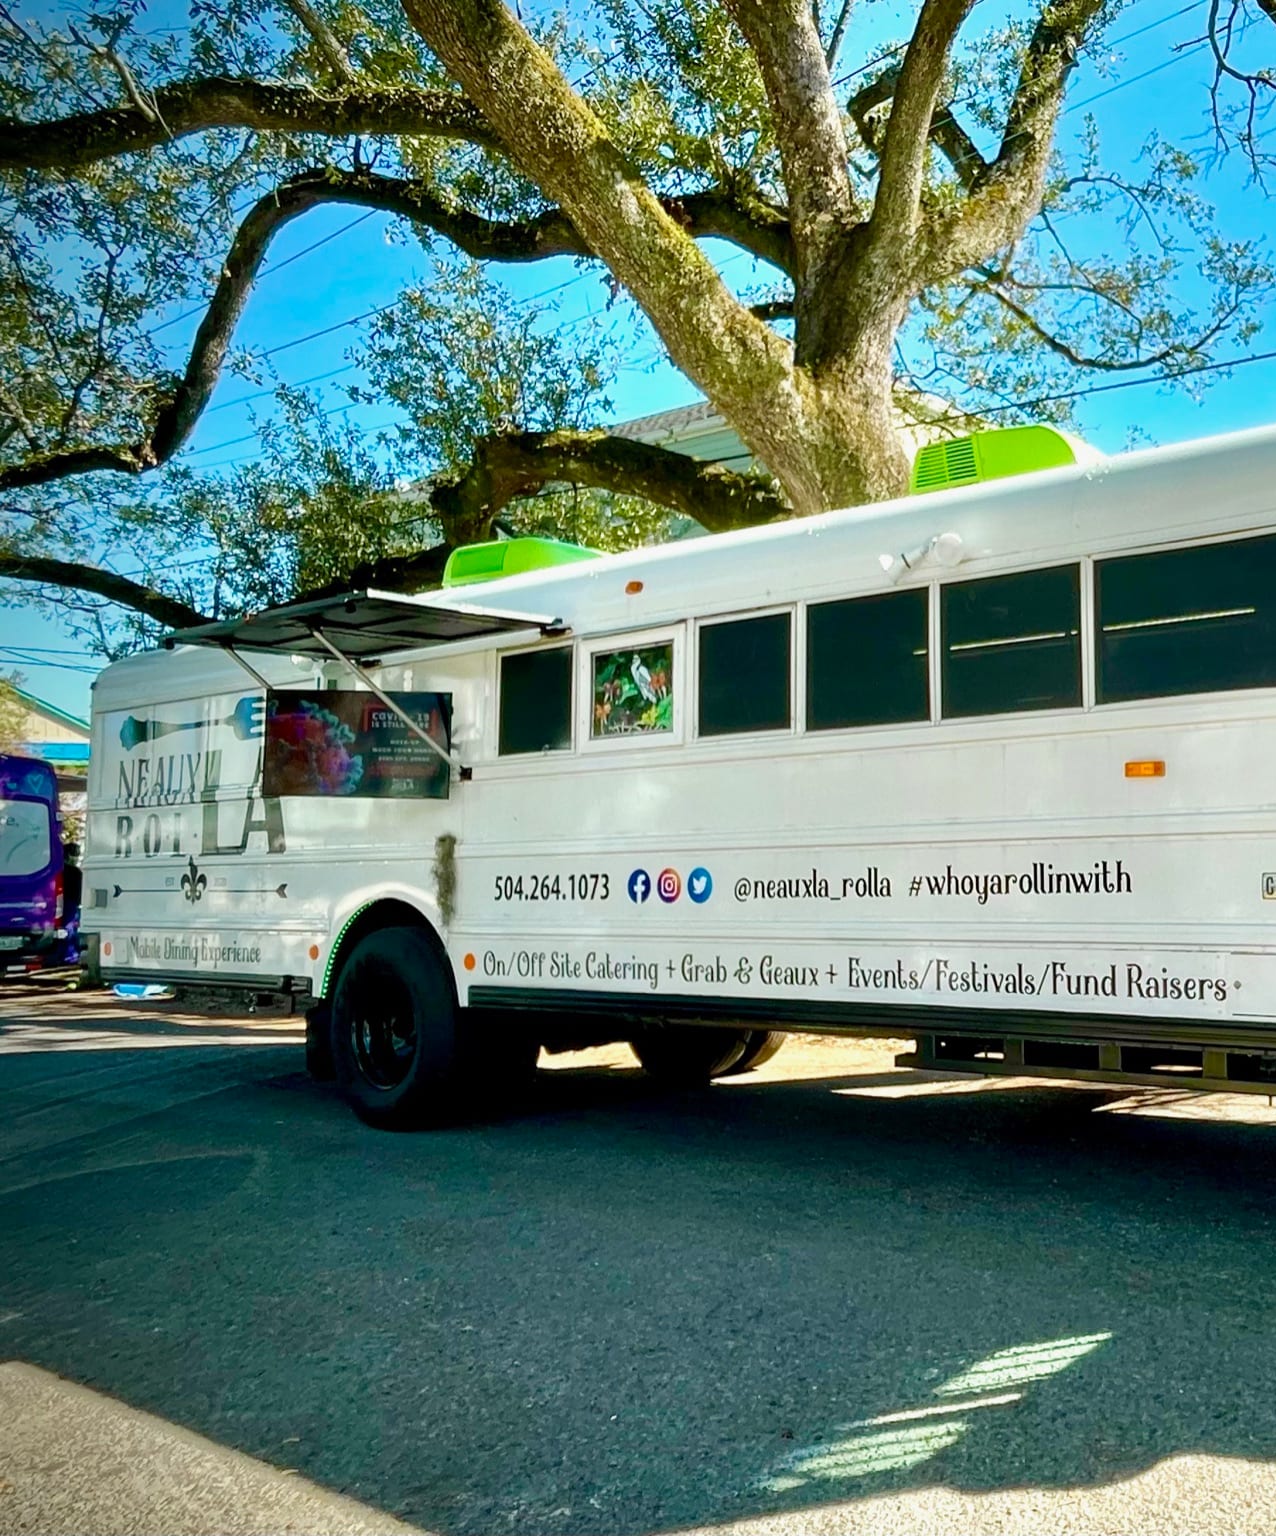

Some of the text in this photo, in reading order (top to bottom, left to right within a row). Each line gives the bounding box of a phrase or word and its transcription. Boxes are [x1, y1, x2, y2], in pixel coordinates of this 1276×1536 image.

[494, 860, 1133, 905] 504.264.1073 @neauxla_rolla #whoyarollinwith
[130, 935, 262, 968] Mobile Dining Experience
[483, 951, 546, 978] On/Off
[550, 951, 582, 979] Site
[585, 952, 659, 990] Catering
[681, 953, 727, 984] Grab
[733, 957, 754, 985] &
[760, 955, 819, 987] Geaux
[847, 957, 1117, 998] Events/Festivals/Fund
[1126, 962, 1228, 1001] Raisers
